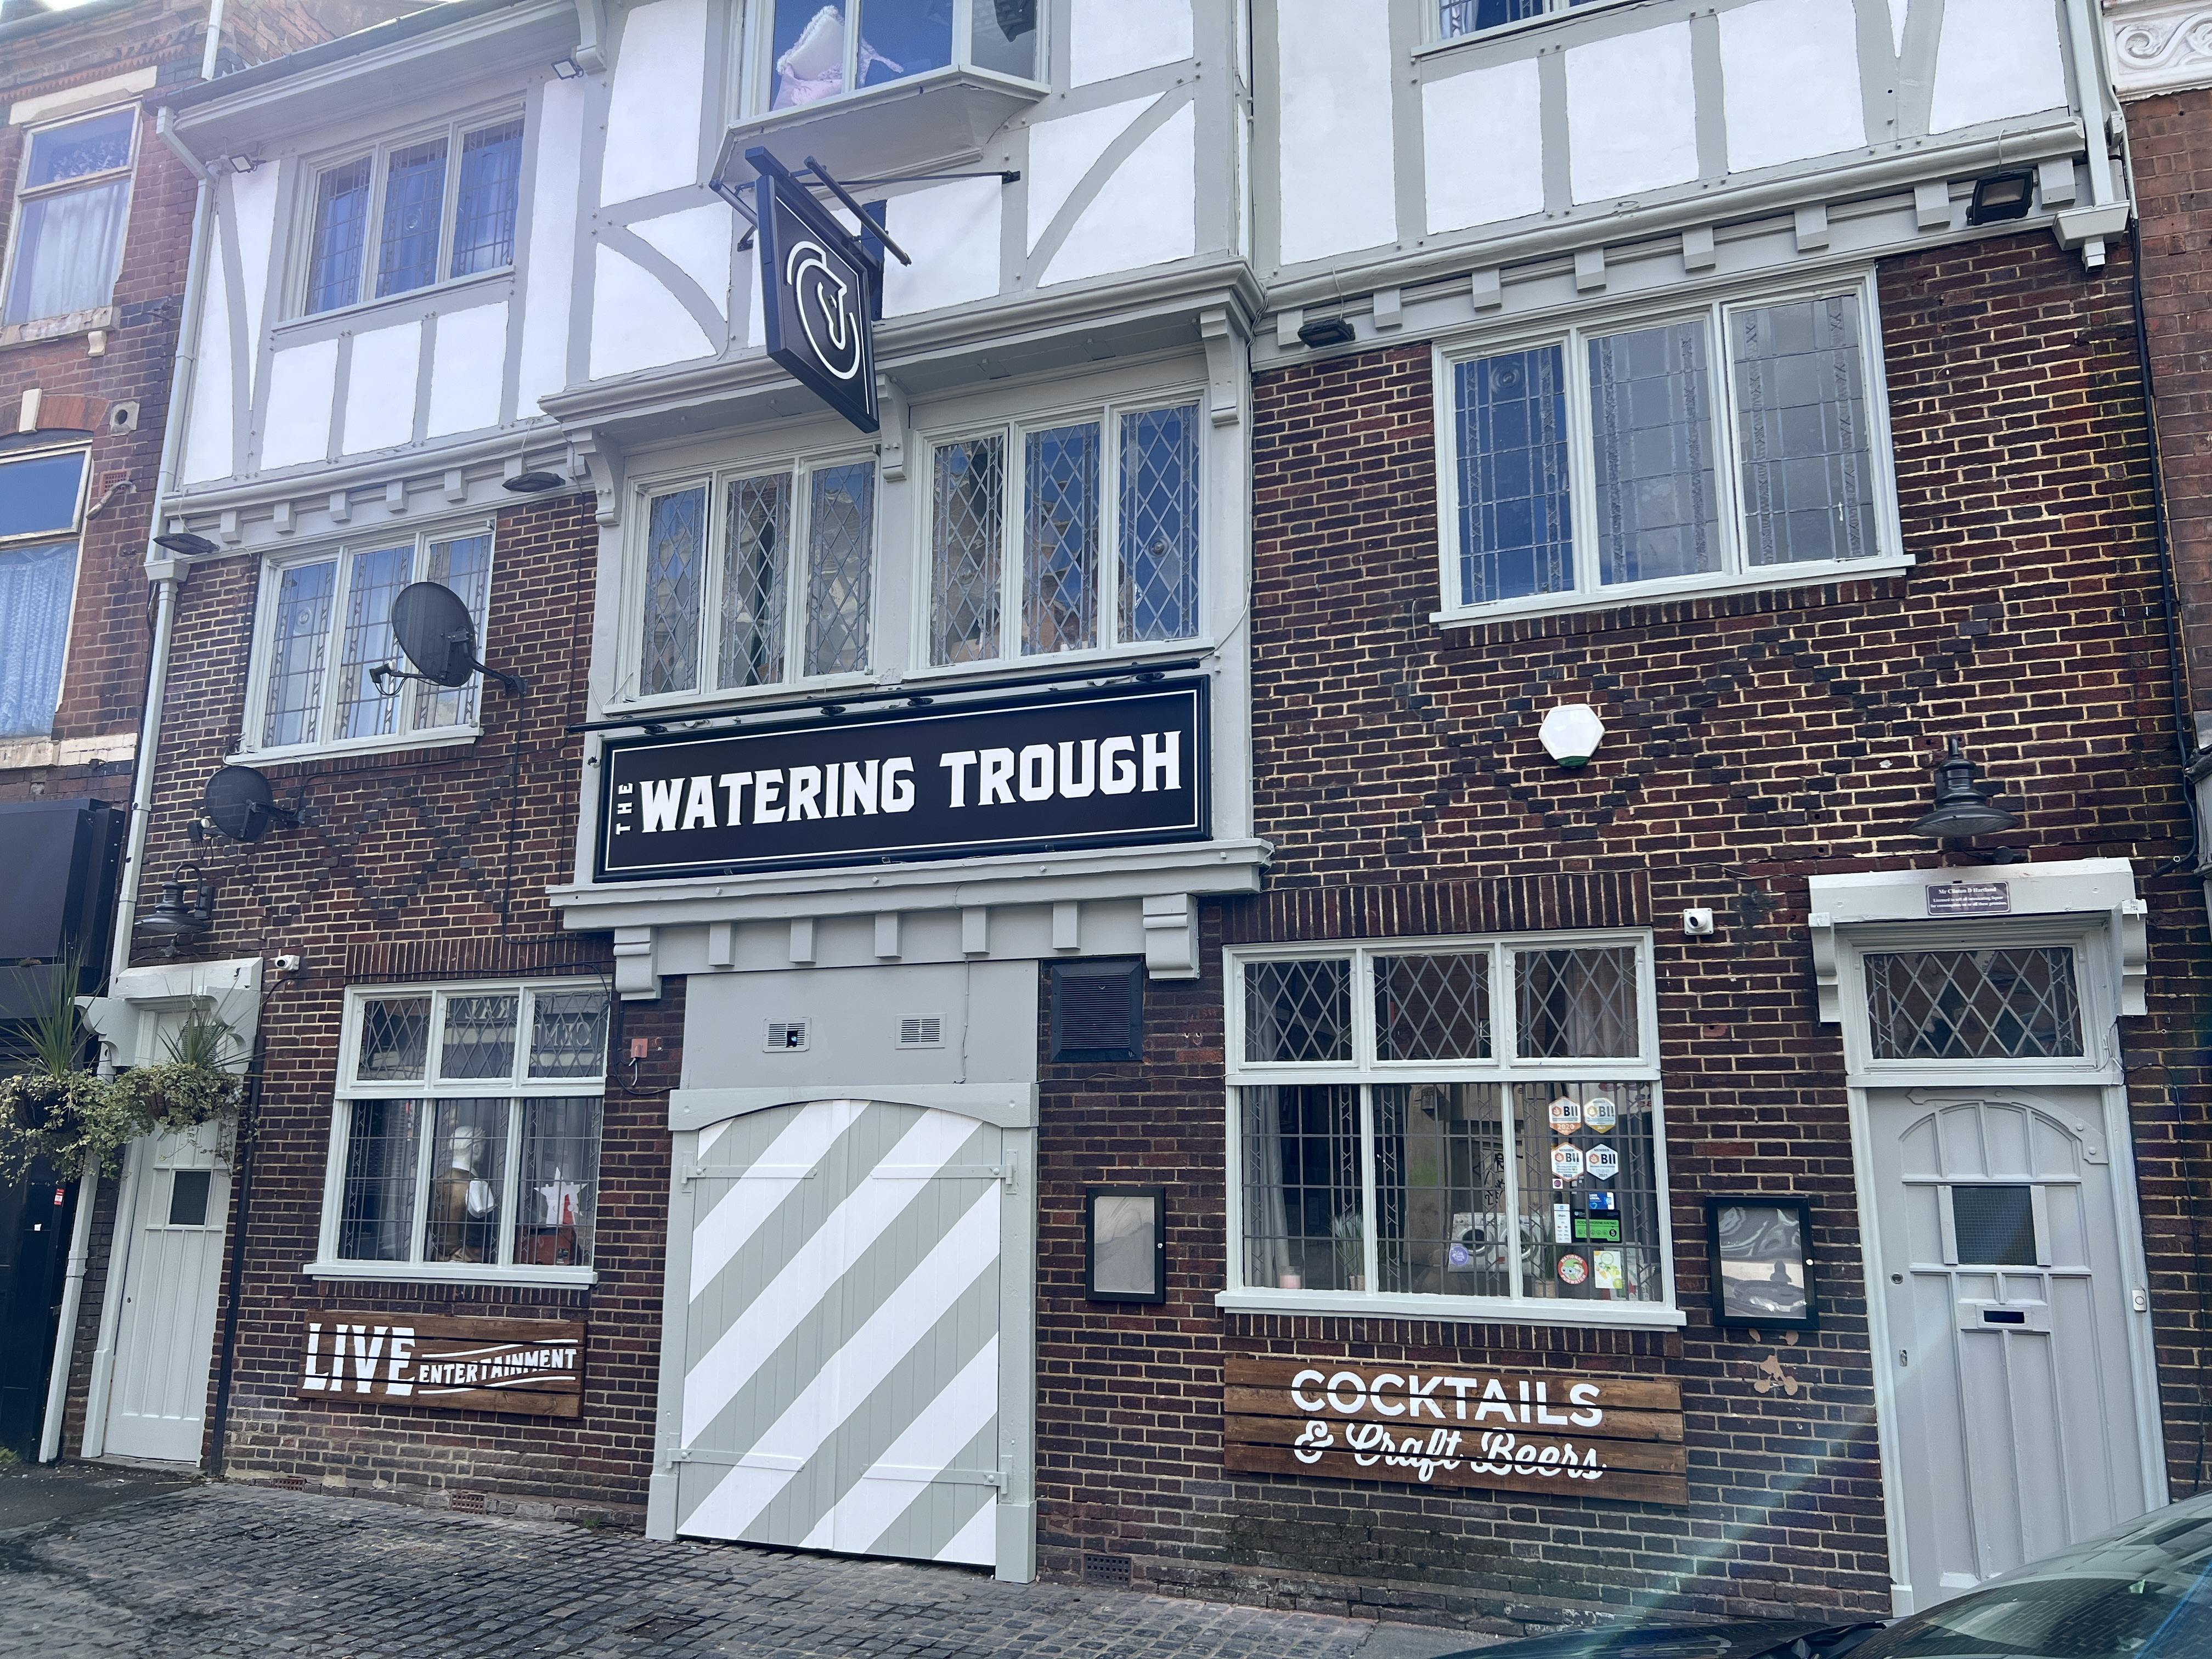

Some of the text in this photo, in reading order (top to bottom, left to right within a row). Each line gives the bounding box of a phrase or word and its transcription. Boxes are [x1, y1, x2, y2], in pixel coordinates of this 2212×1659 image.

[616, 730, 1182, 835] THE WATERING TROUGH
[1560, 1254, 1583, 1263] NATIONAL
[302, 1323, 577, 1396] LIVE ENTERTAINMENT
[1290, 1369, 1602, 1427] COCKTAILS
[1294, 1420, 1607, 1482] & Craft Beers
